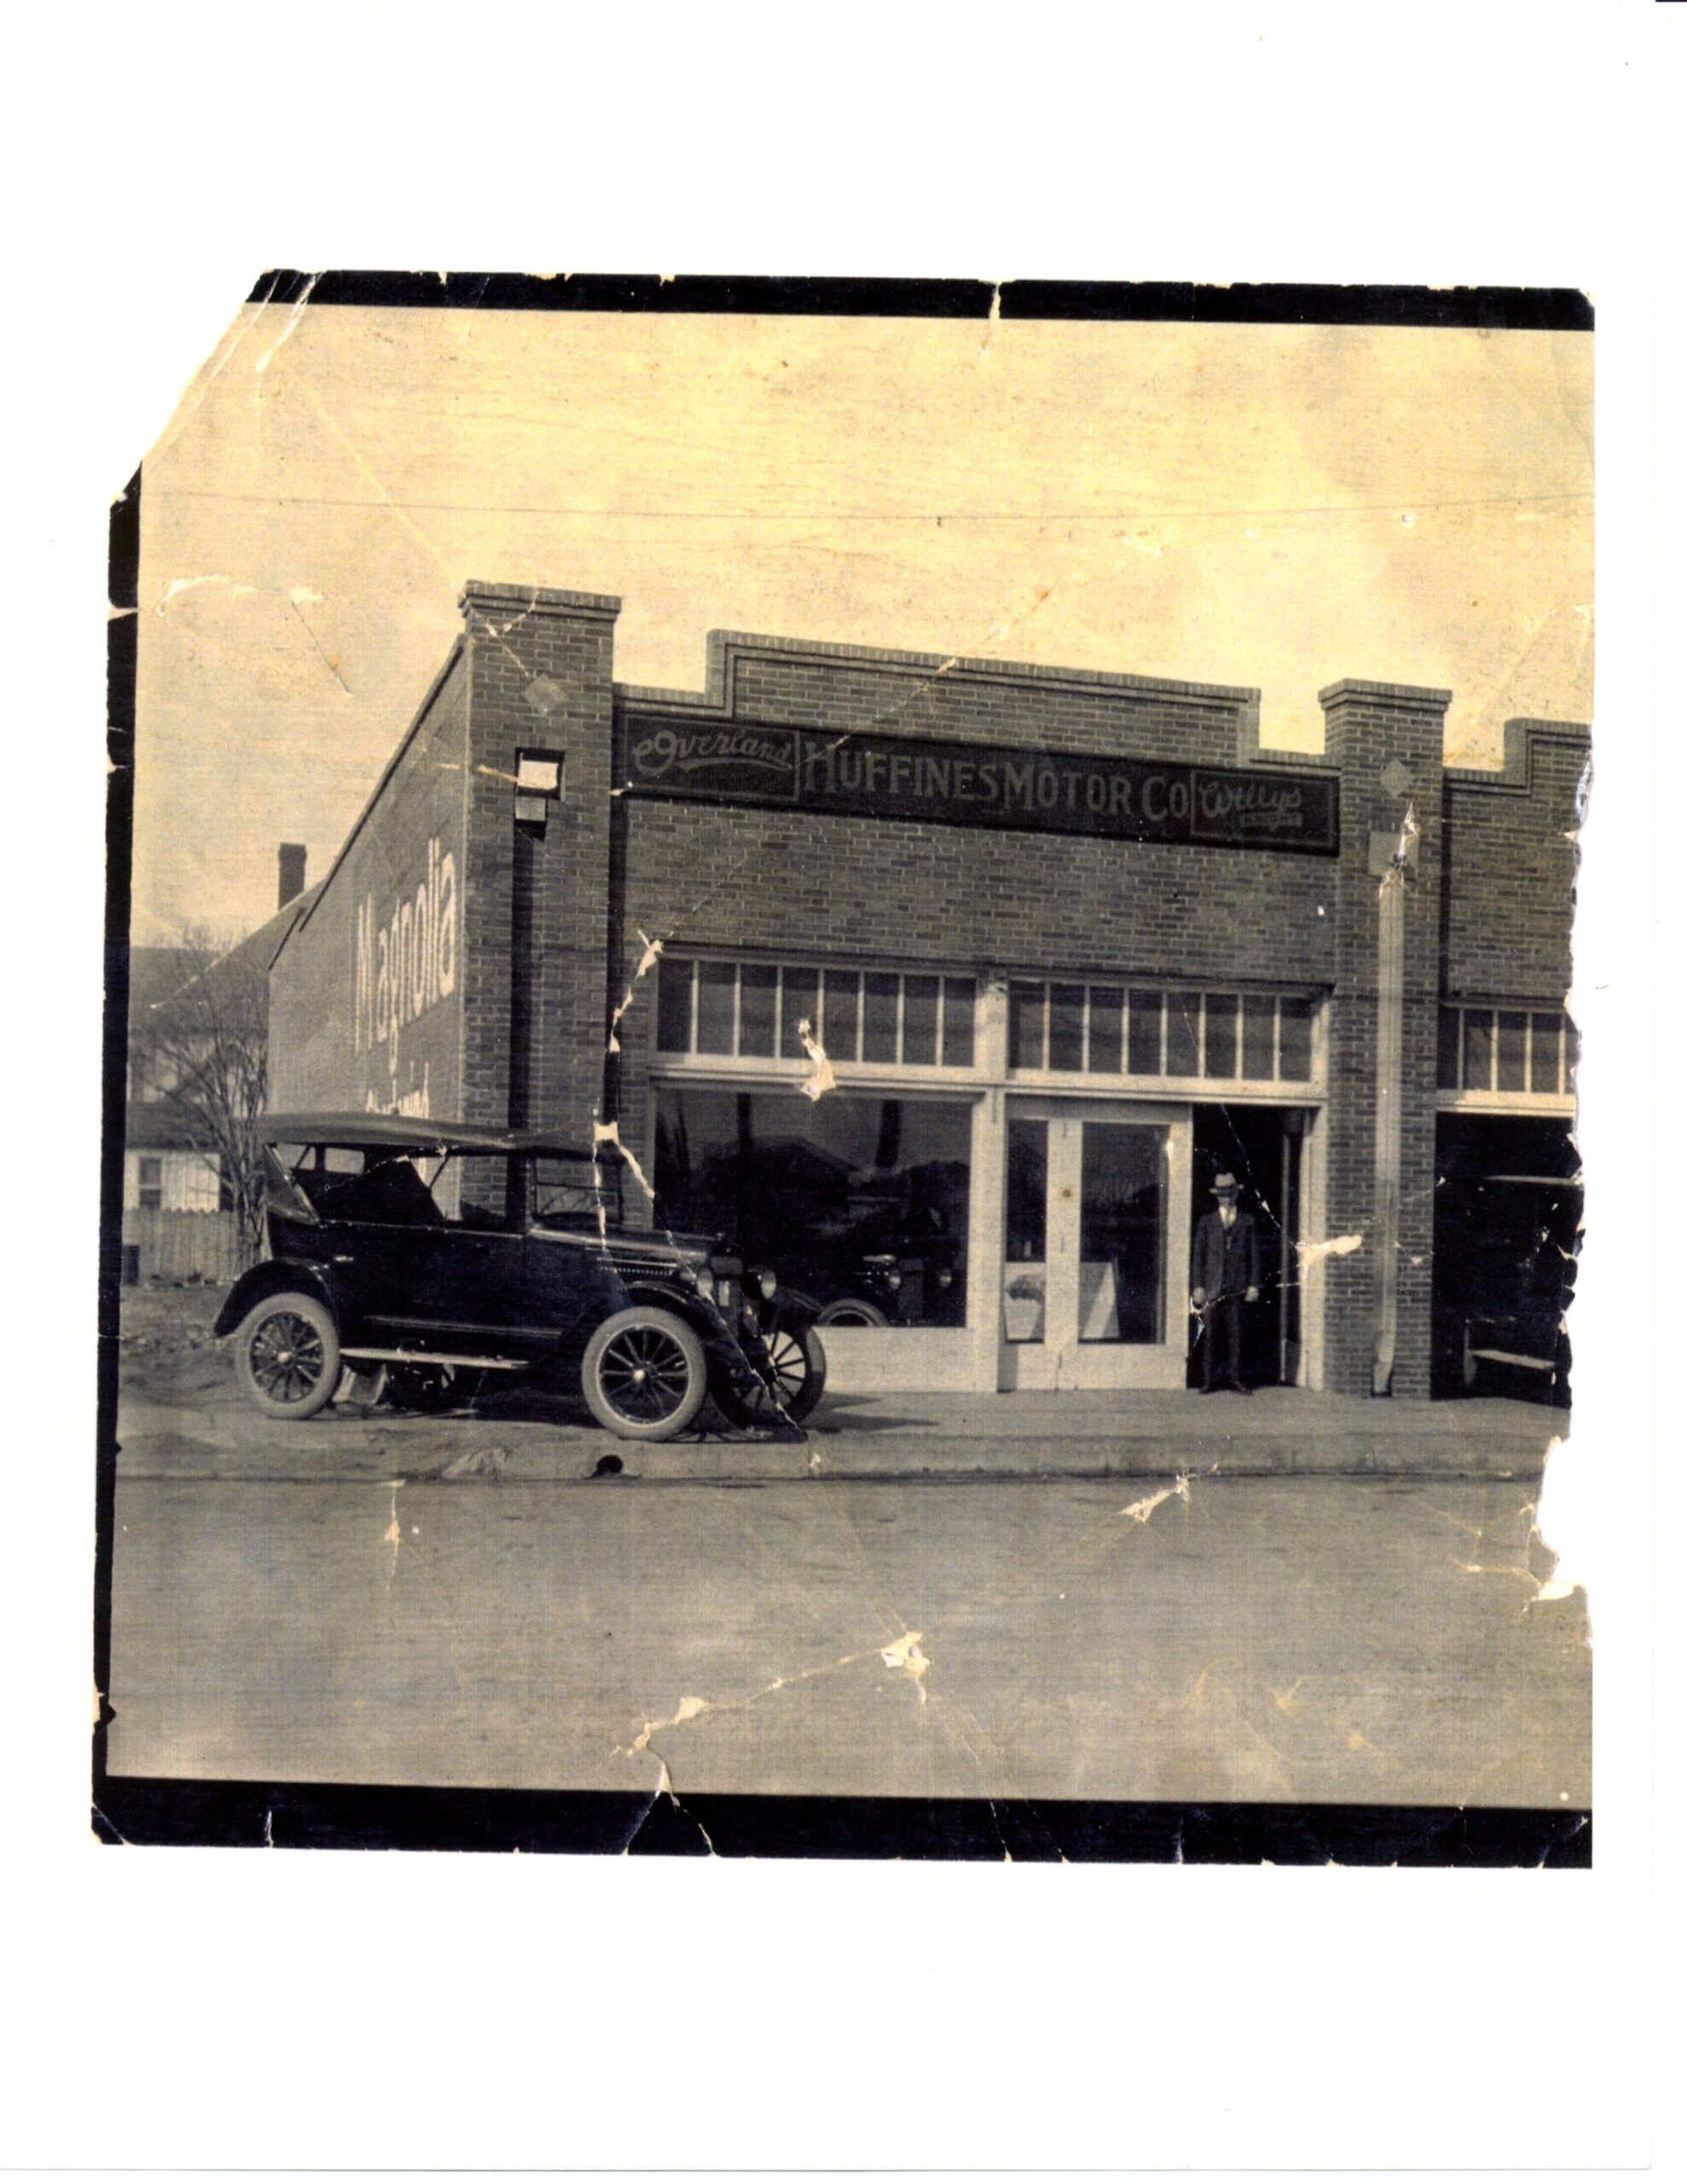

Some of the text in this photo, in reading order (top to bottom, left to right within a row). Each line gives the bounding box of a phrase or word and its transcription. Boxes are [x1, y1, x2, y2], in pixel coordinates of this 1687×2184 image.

[633, 729, 792, 776] Overland
[804, 741, 998, 800] HUFFINES
[1003, 761, 1133, 816] MOTOR
[355, 835, 456, 1076] Magnolia
